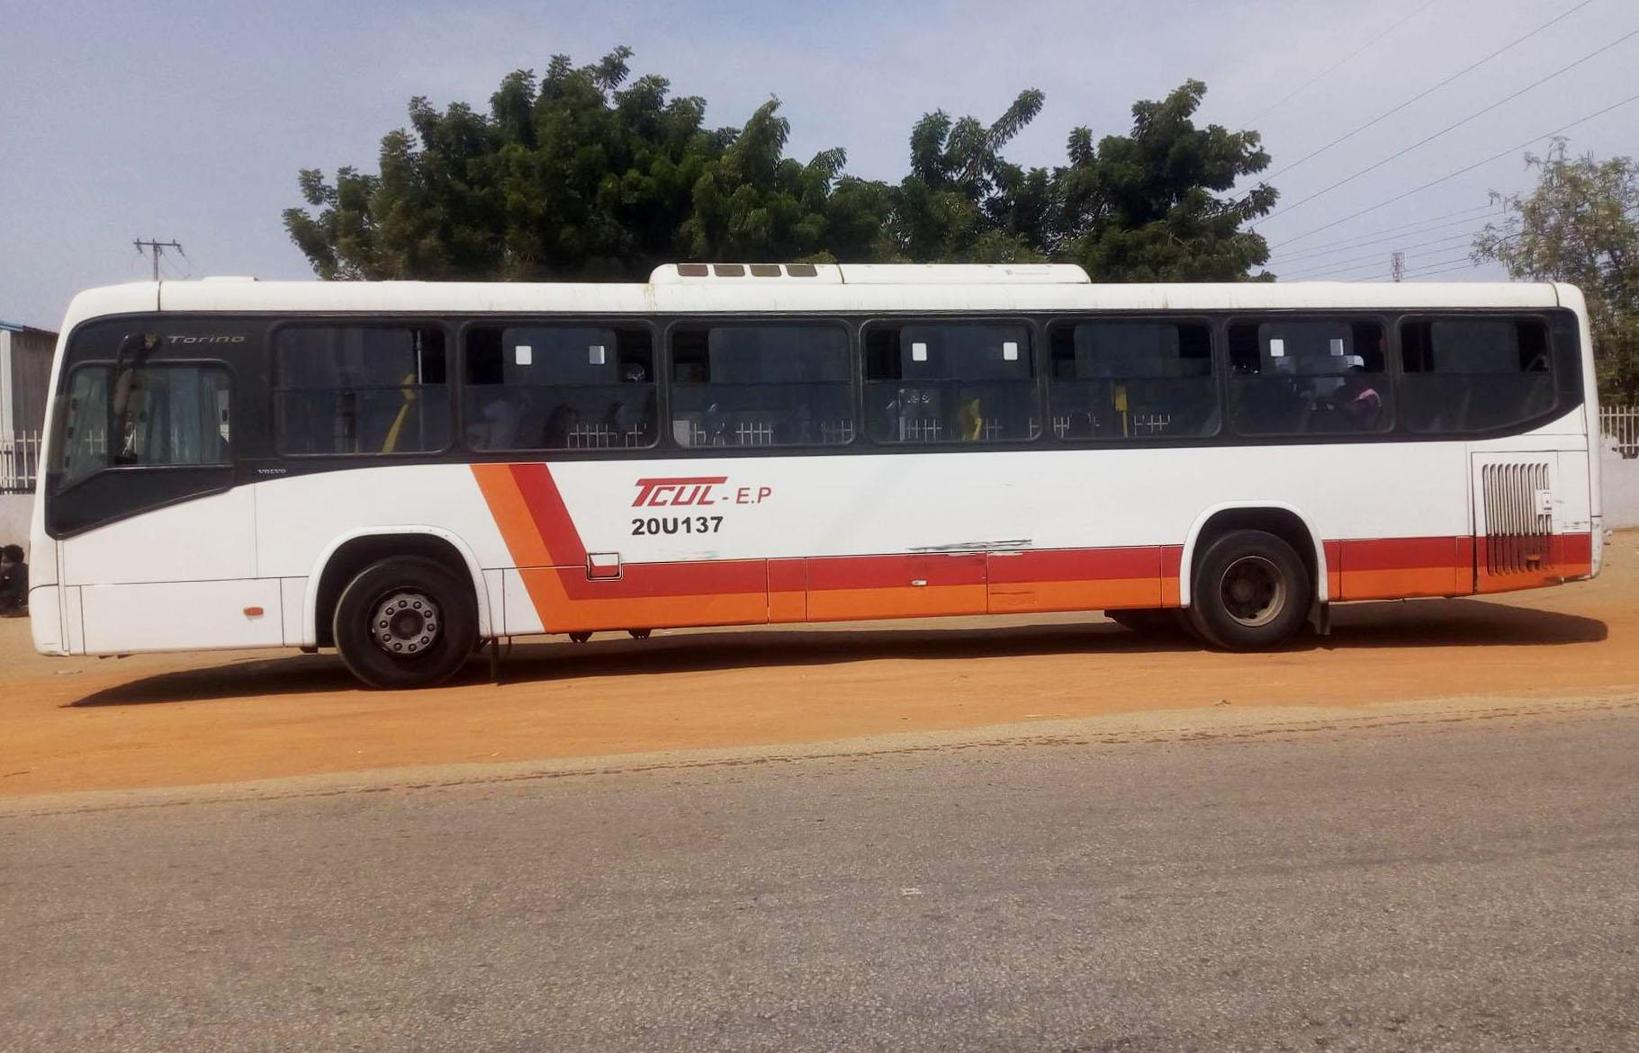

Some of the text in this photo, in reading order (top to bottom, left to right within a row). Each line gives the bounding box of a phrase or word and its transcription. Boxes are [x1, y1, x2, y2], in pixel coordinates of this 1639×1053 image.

[167, 335, 246, 344] Torino
[631, 476, 728, 507] TCUL
[631, 516, 724, 536] 20U137
